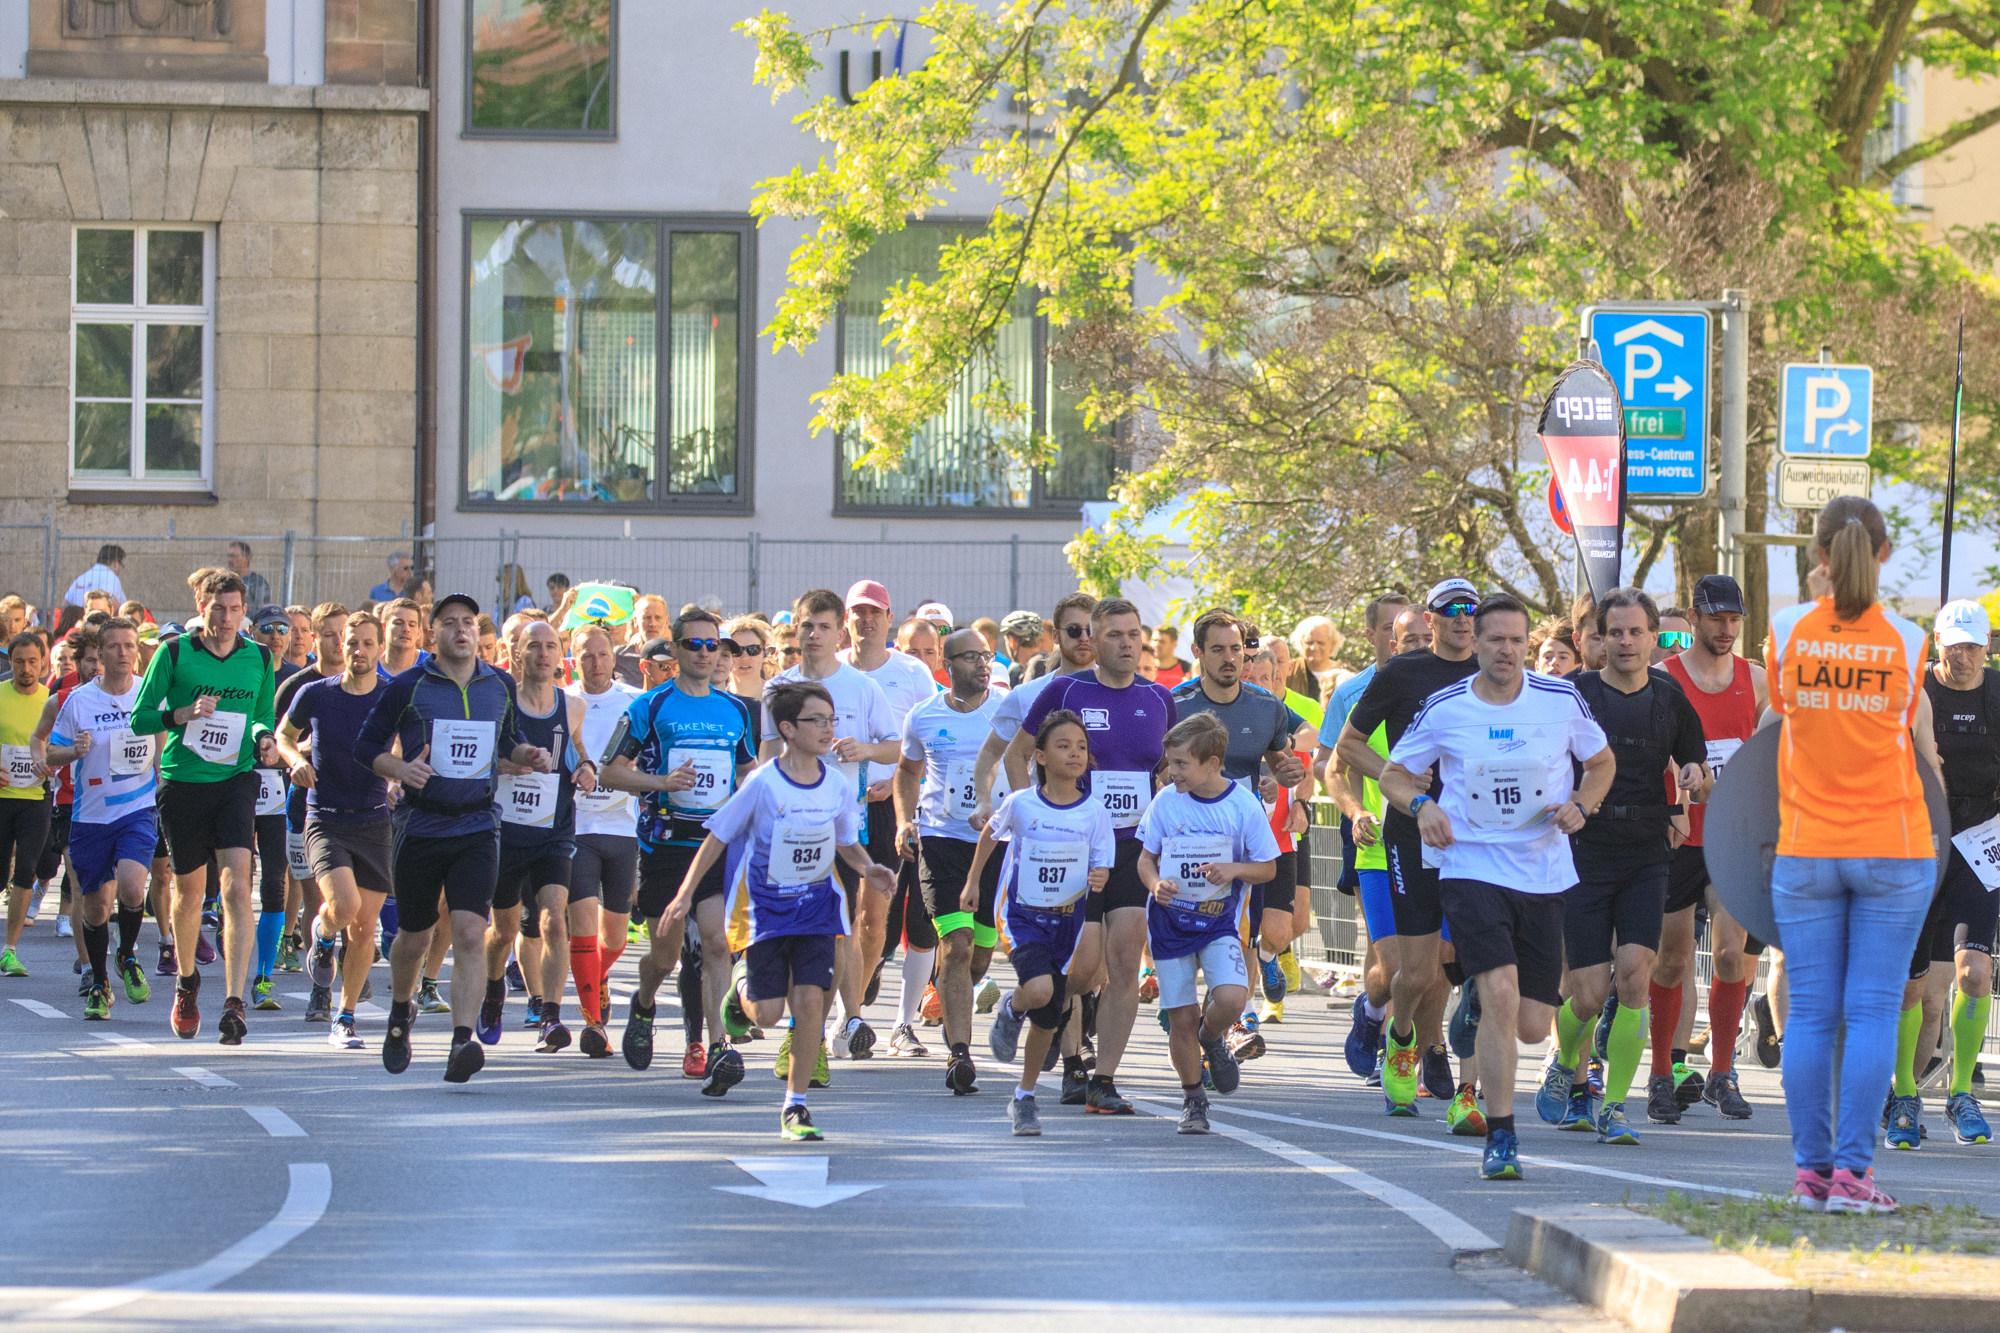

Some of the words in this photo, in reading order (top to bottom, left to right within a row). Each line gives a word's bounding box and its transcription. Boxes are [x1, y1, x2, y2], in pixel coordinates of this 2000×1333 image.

[1624, 344, 1662, 400] P
[1804, 377, 1851, 444] P
[1630, 411, 1664, 433] frei
[1656, 467, 1695, 478] HOTEL
[1786, 466, 1865, 486] Ausweichparkplatz
[1807, 487, 1839, 501] CCW
[1796, 639, 1897, 664] PARKETT
[1797, 660, 1893, 692] LÄUFT
[1796, 690, 1829, 710] BEI
[1837, 693, 1890, 713] UNS!
[200, 730, 228, 745] 2116
[123, 745, 148, 758] 1622
[450, 743, 477, 758] 1712
[694, 773, 715, 788] 29
[512, 791, 540, 807] 1441
[1103, 794, 1138, 810] 2501
[1492, 787, 1521, 806] 115
[793, 847, 821, 864] 834
[1038, 867, 1066, 883] 837
